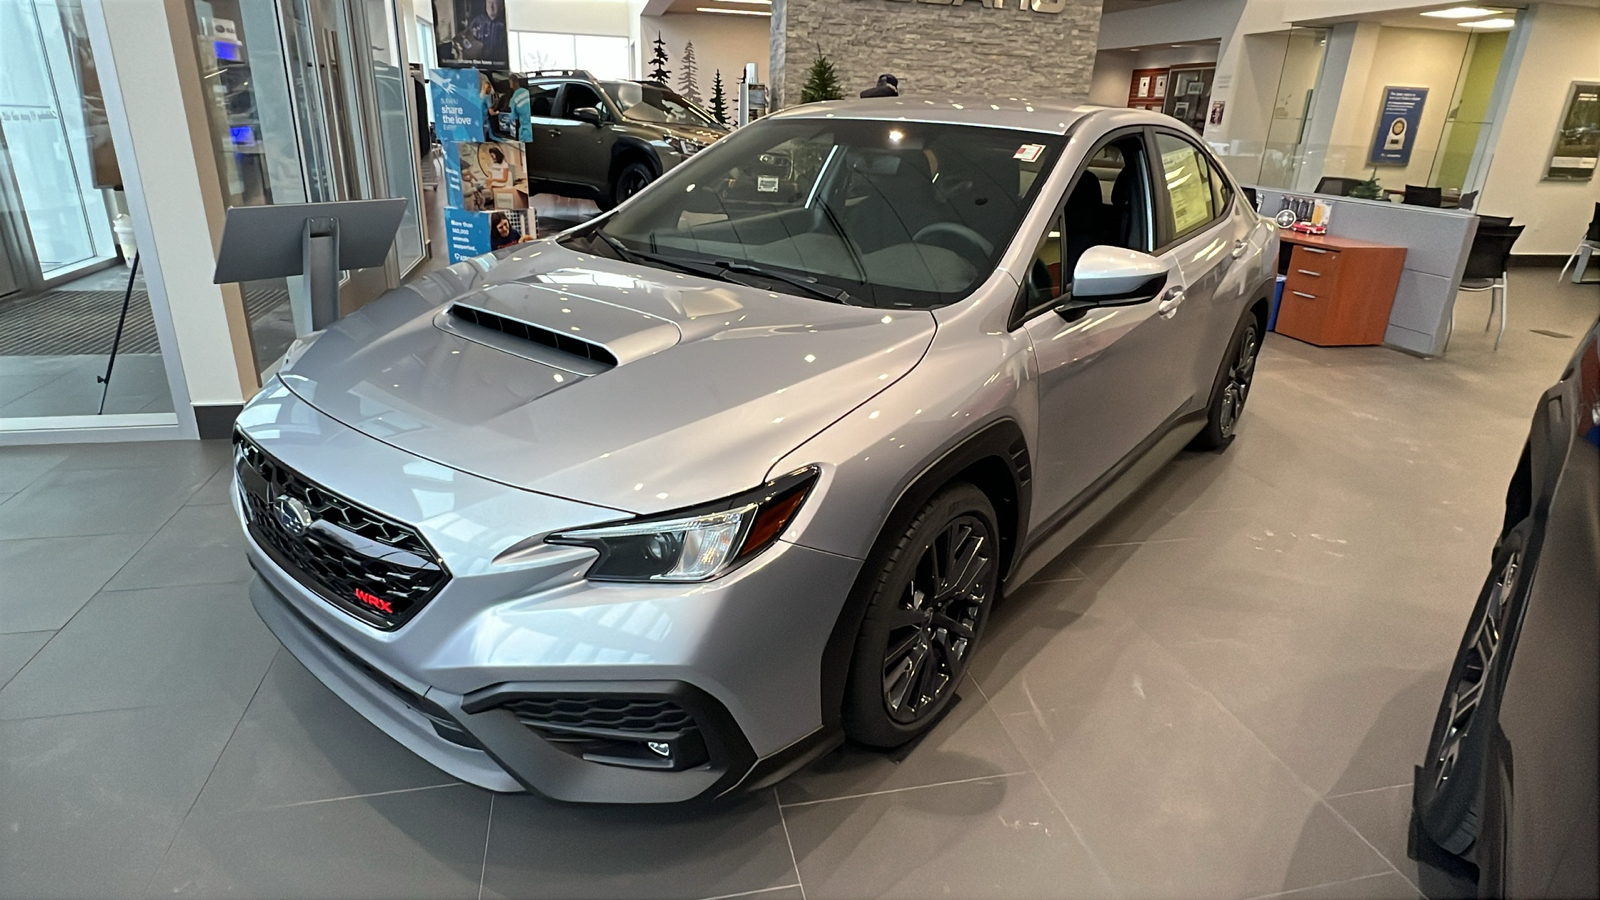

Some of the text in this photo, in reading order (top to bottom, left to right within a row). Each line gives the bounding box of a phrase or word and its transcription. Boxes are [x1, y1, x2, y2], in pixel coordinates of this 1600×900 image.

[441, 105, 463, 115] share
[443, 115, 471, 124] the love
[355, 588, 393, 614] WRX
